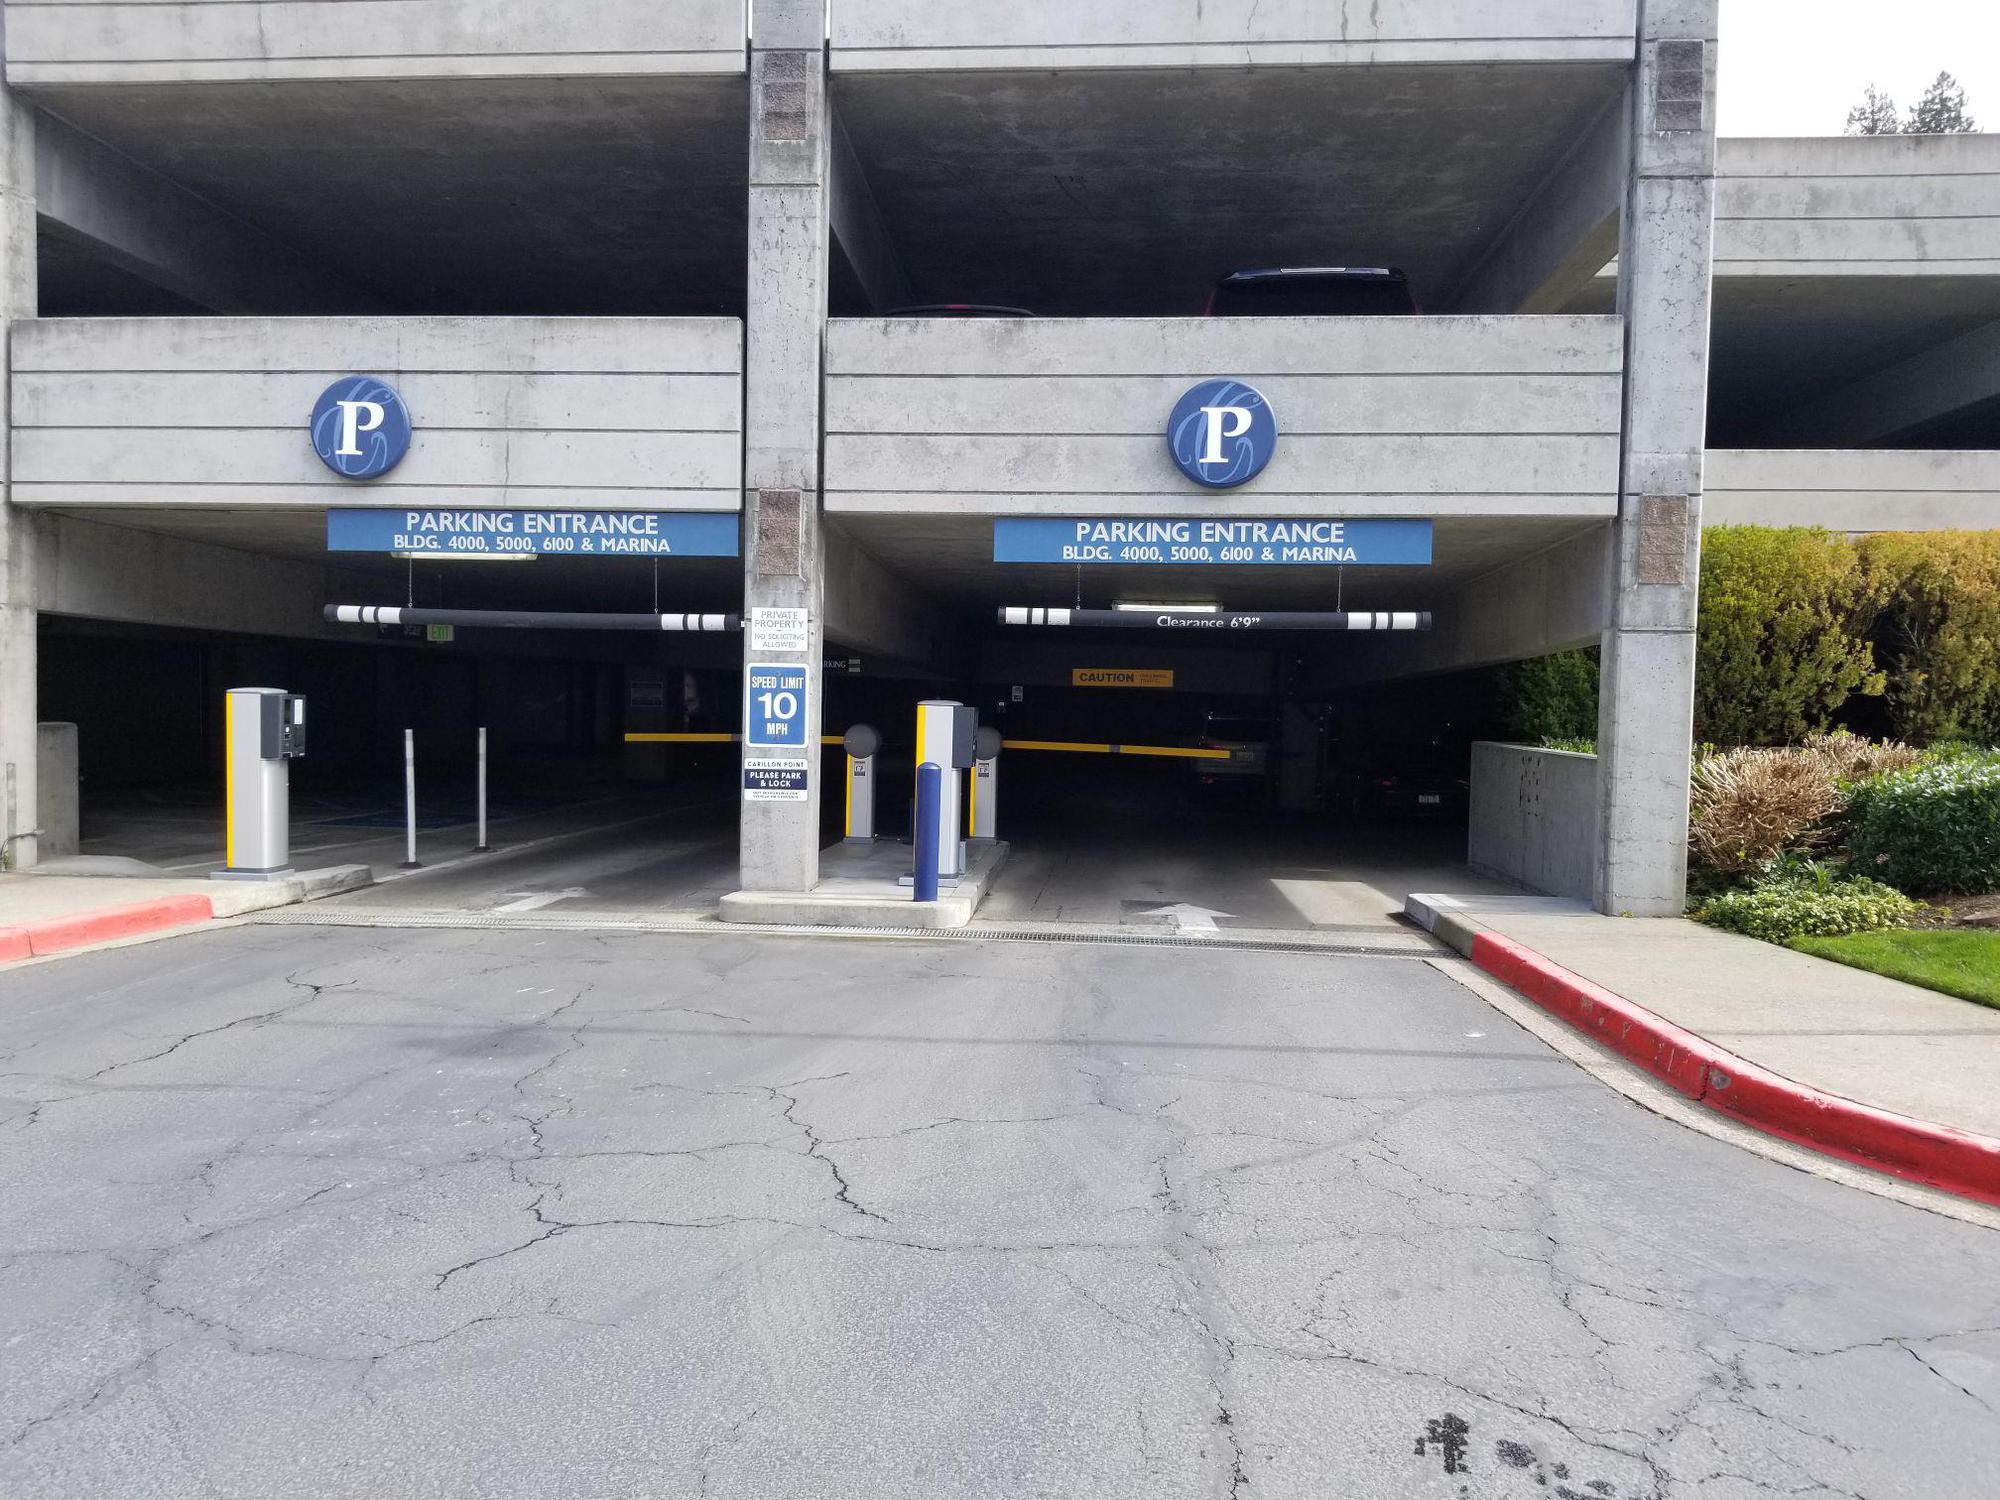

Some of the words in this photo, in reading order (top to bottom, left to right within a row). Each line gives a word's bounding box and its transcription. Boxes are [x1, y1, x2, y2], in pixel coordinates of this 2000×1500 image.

[335, 400, 384, 456] P
[1199, 406, 1252, 463] P
[406, 512, 514, 533] PARKING
[524, 514, 658, 535] ENTRANCE
[1076, 522, 1189, 543] PARKING
[1200, 523, 1344, 543] ENTRANCE
[394, 534, 442, 549] BLDG.
[448, 537, 489, 552] 4000,
[496, 537, 536, 552] 5000,
[543, 537, 574, 551] 6100
[581, 537, 594, 552] &
[601, 538, 671, 553] MARINA
[1063, 546, 1112, 560] BLDG.
[1120, 547, 1163, 562] 4000,
[1171, 547, 1213, 562] 5000,
[1220, 547, 1253, 561] 6100
[1261, 547, 1274, 561] &
[1282, 547, 1357, 561] MARINA
[761, 611, 798, 620] PRIVATE
[1156, 615, 1224, 628] Clearance
[754, 620, 804, 628] PROPERTY
[768, 633, 805, 641] SOLICITING
[752, 676, 777, 689] SPEED
[781, 677, 804, 689] LIMIT
[1080, 673, 1135, 682] CAUTION
[758, 692, 797, 719] 10
[766, 723, 788, 735] MPH
[750, 771, 779, 779] PLEASE
